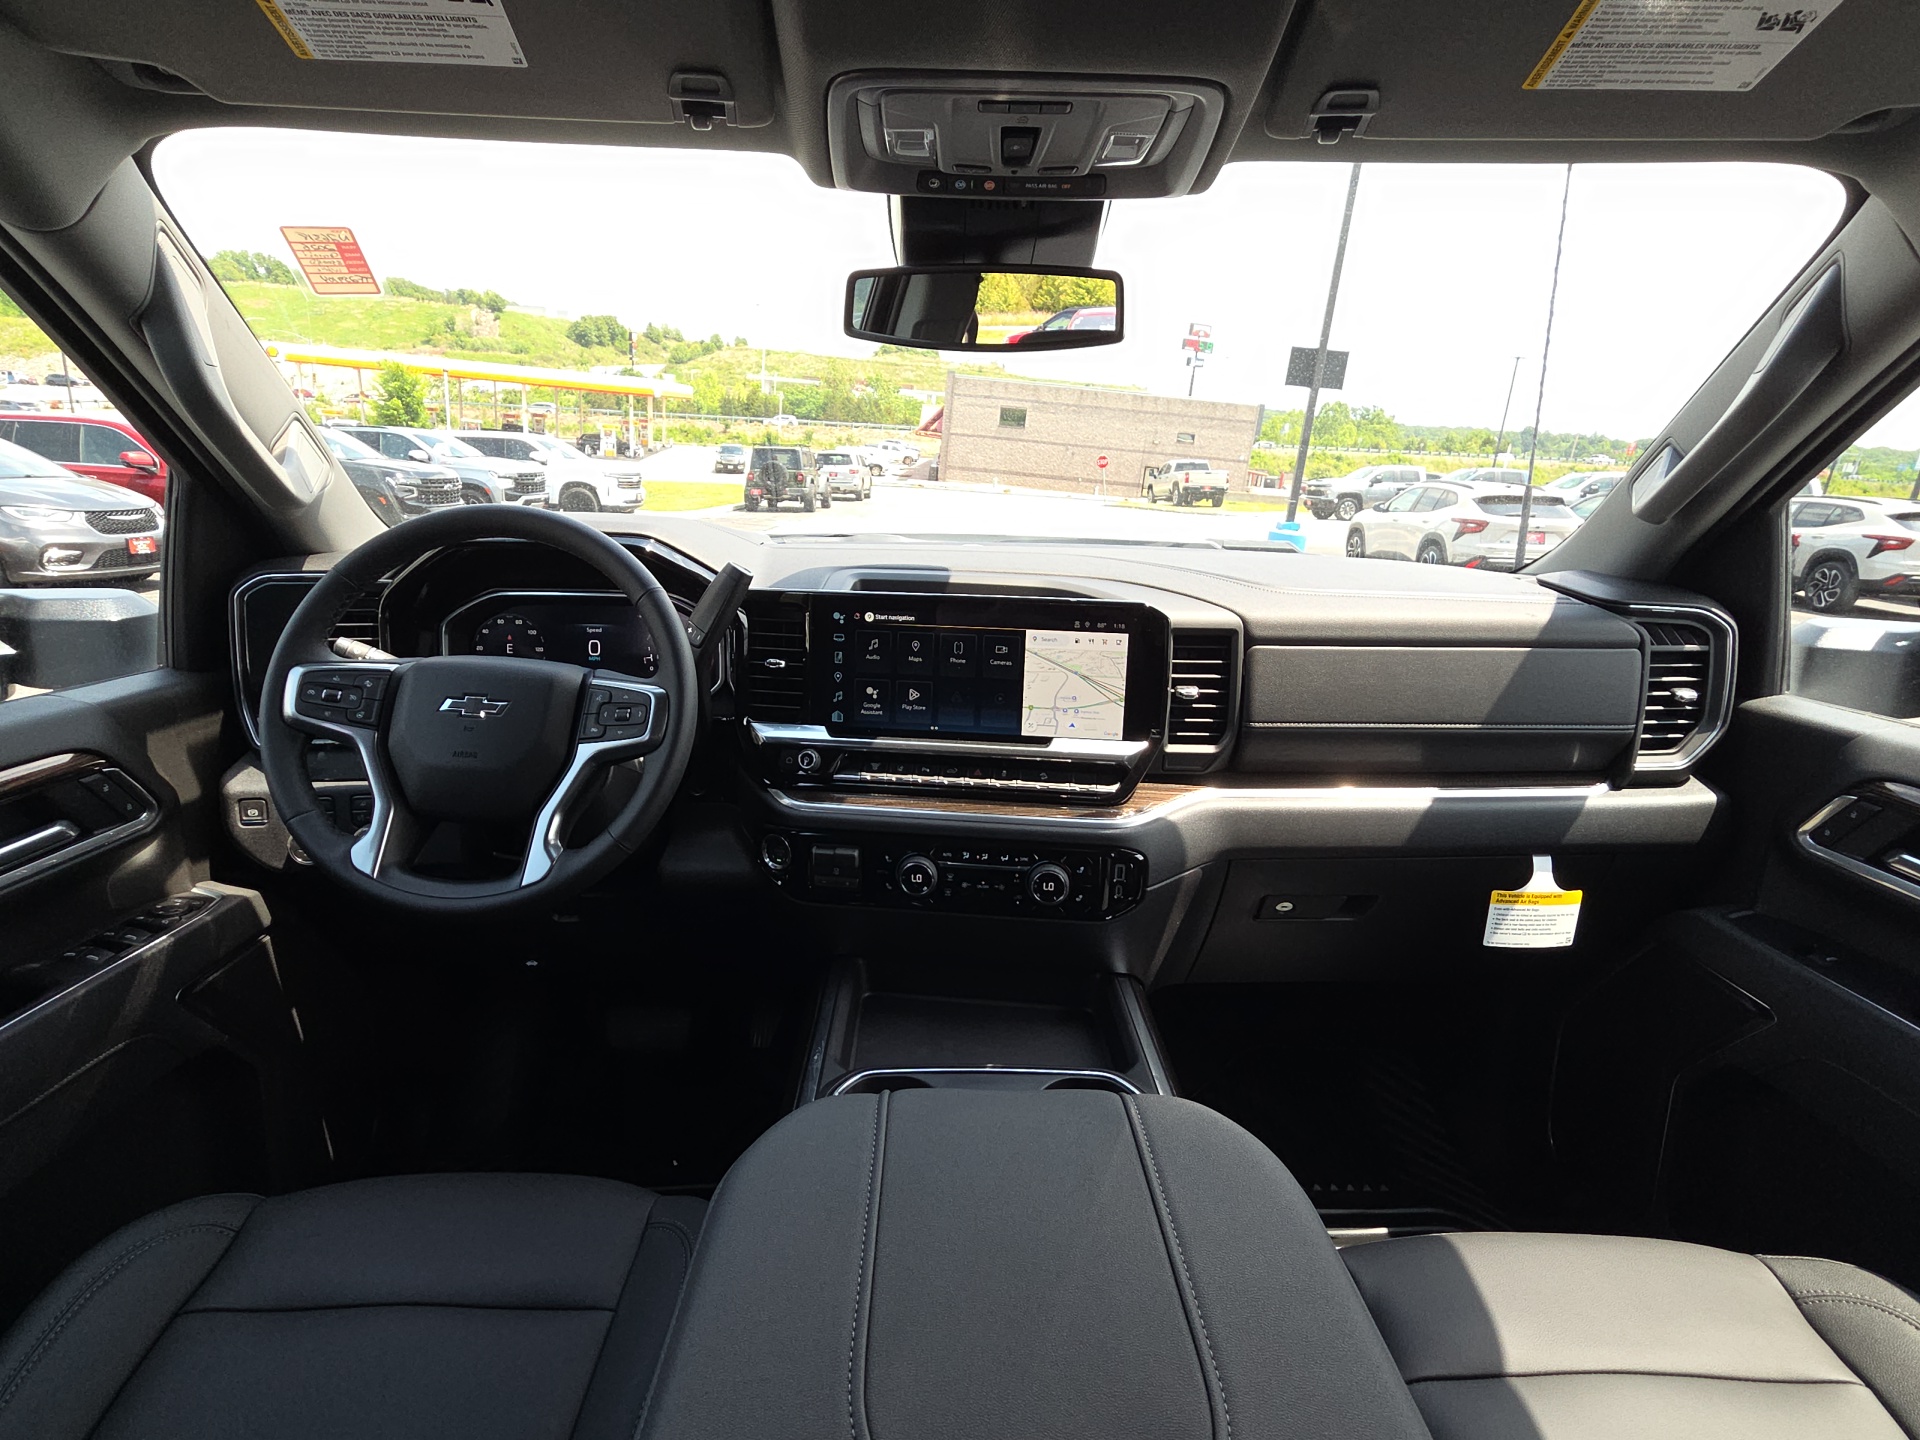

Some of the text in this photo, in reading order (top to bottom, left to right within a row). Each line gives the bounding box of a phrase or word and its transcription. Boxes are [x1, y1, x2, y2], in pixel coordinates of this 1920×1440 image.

[311, 9, 332, 17] AVEC
[333, 10, 350, 18] DES
[424, 15, 478, 23] INTELLIGENTS
[506, 643, 513, 654] E
[588, 639, 601, 656] 0
